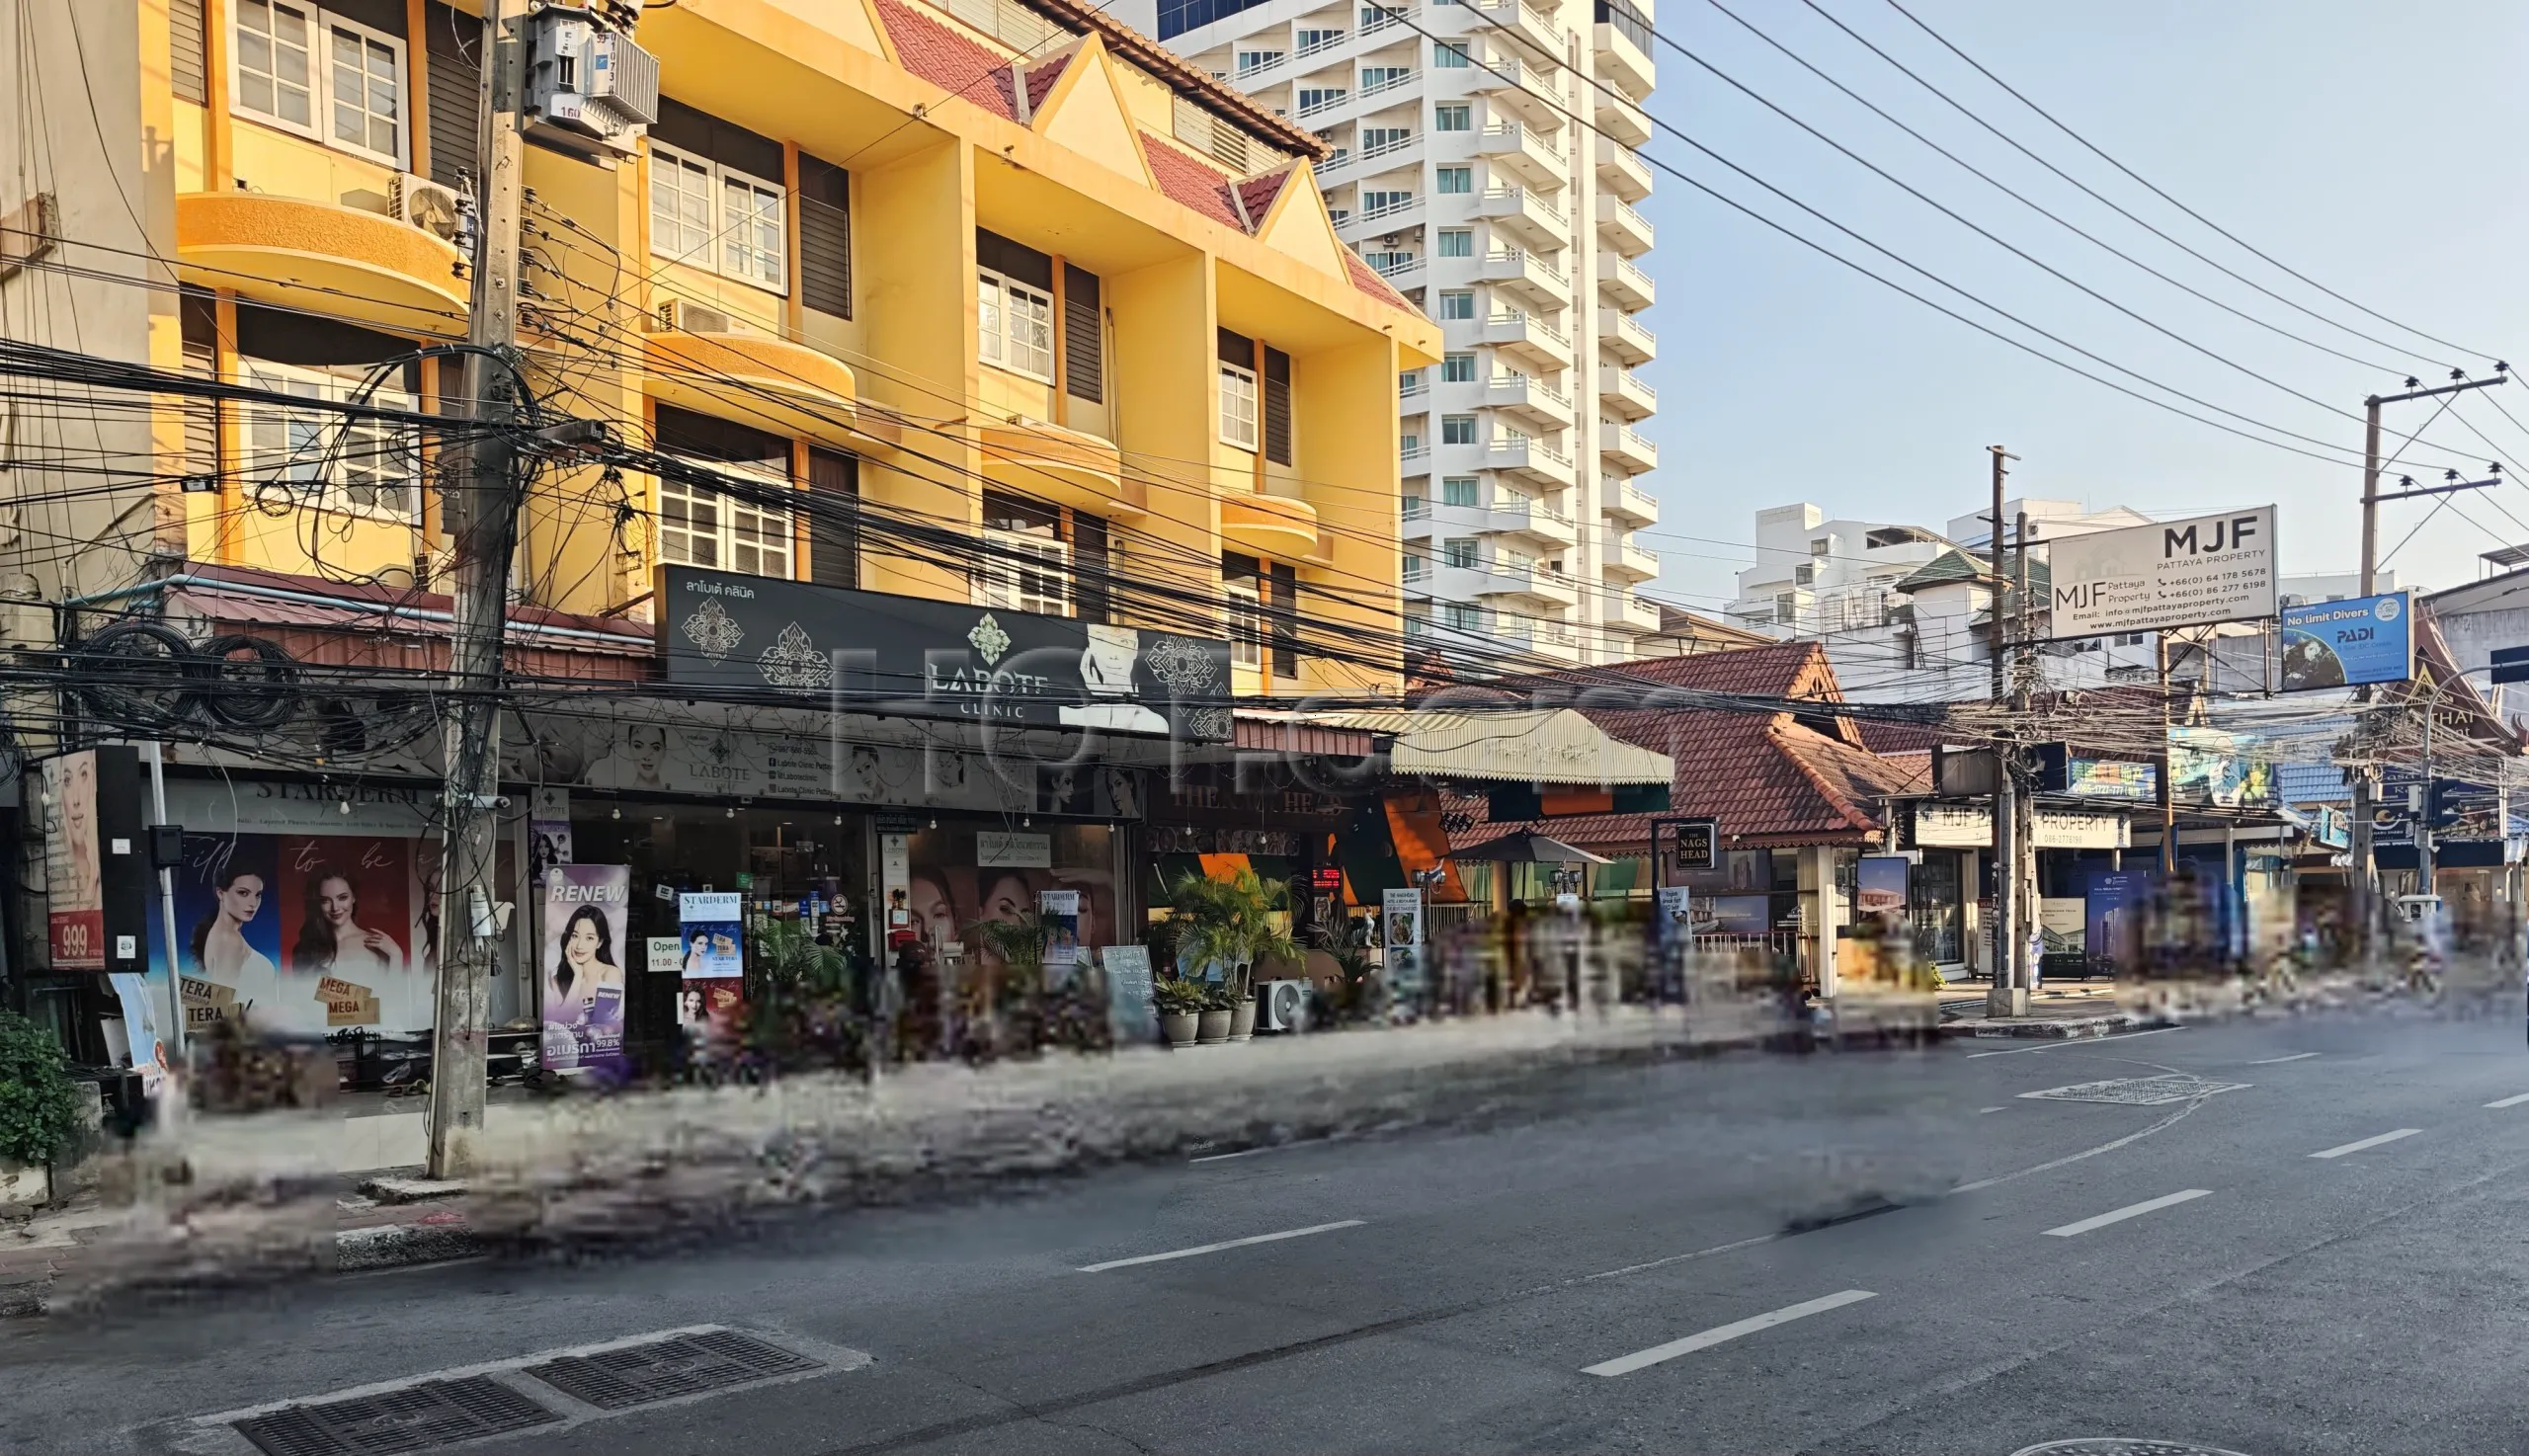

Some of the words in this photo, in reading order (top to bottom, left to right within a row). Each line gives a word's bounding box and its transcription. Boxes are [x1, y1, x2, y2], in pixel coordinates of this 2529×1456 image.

[2164, 515, 2258, 559] MJF
[2157, 559, 2203, 571] PATTAYA
[2206, 549, 2266, 564] PROPERTY
[2107, 579, 2146, 591] Pattaya
[2169, 575, 2203, 586] +66(0)
[2206, 574, 2219, 583] 64
[2222, 571, 2239, 580] 178
[2242, 567, 2266, 578] 5678
[2055, 581, 2107, 611] MJF
[2107, 592, 2152, 604] Property
[2169, 588, 2203, 599] +66(0)
[2206, 586, 2219, 595] 86
[2222, 583, 2240, 593] 277
[2243, 580, 2266, 590] 6198
[2073, 610, 2100, 621] Email:
[2089, 607, 2232, 629] www.mjfpattayaproperty.com
[2287, 616, 2303, 626] No
[2305, 612, 2330, 624] limit
[2332, 608, 2369, 620] Divers
[2336, 626, 2375, 644] PADI
[929, 663, 1049, 694] LABOTE
[959, 702, 1023, 718] CLINIC
[688, 764, 752, 780] LABOTE
[1942, 806, 1972, 827] MJF
[2042, 811, 2109, 833] PROPERTY
[1679, 838, 1708, 849] NAGS
[289, 840, 326, 872] to
[361, 842, 395, 869] be
[1679, 849, 1708, 859] HEAD
[549, 884, 625, 904] RENEW
[684, 895, 737, 905] STARDERM
[62, 924, 88, 957] 999
[653, 941, 680, 953] Open
[651, 958, 673, 967] 11.00
[320, 976, 351, 996] MEGA
[597, 990, 620, 1000] RENEW
[189, 1007, 224, 1022] TERA
[328, 1000, 360, 1013] MEGA
[596, 1038, 620, 1048] 99.8%
